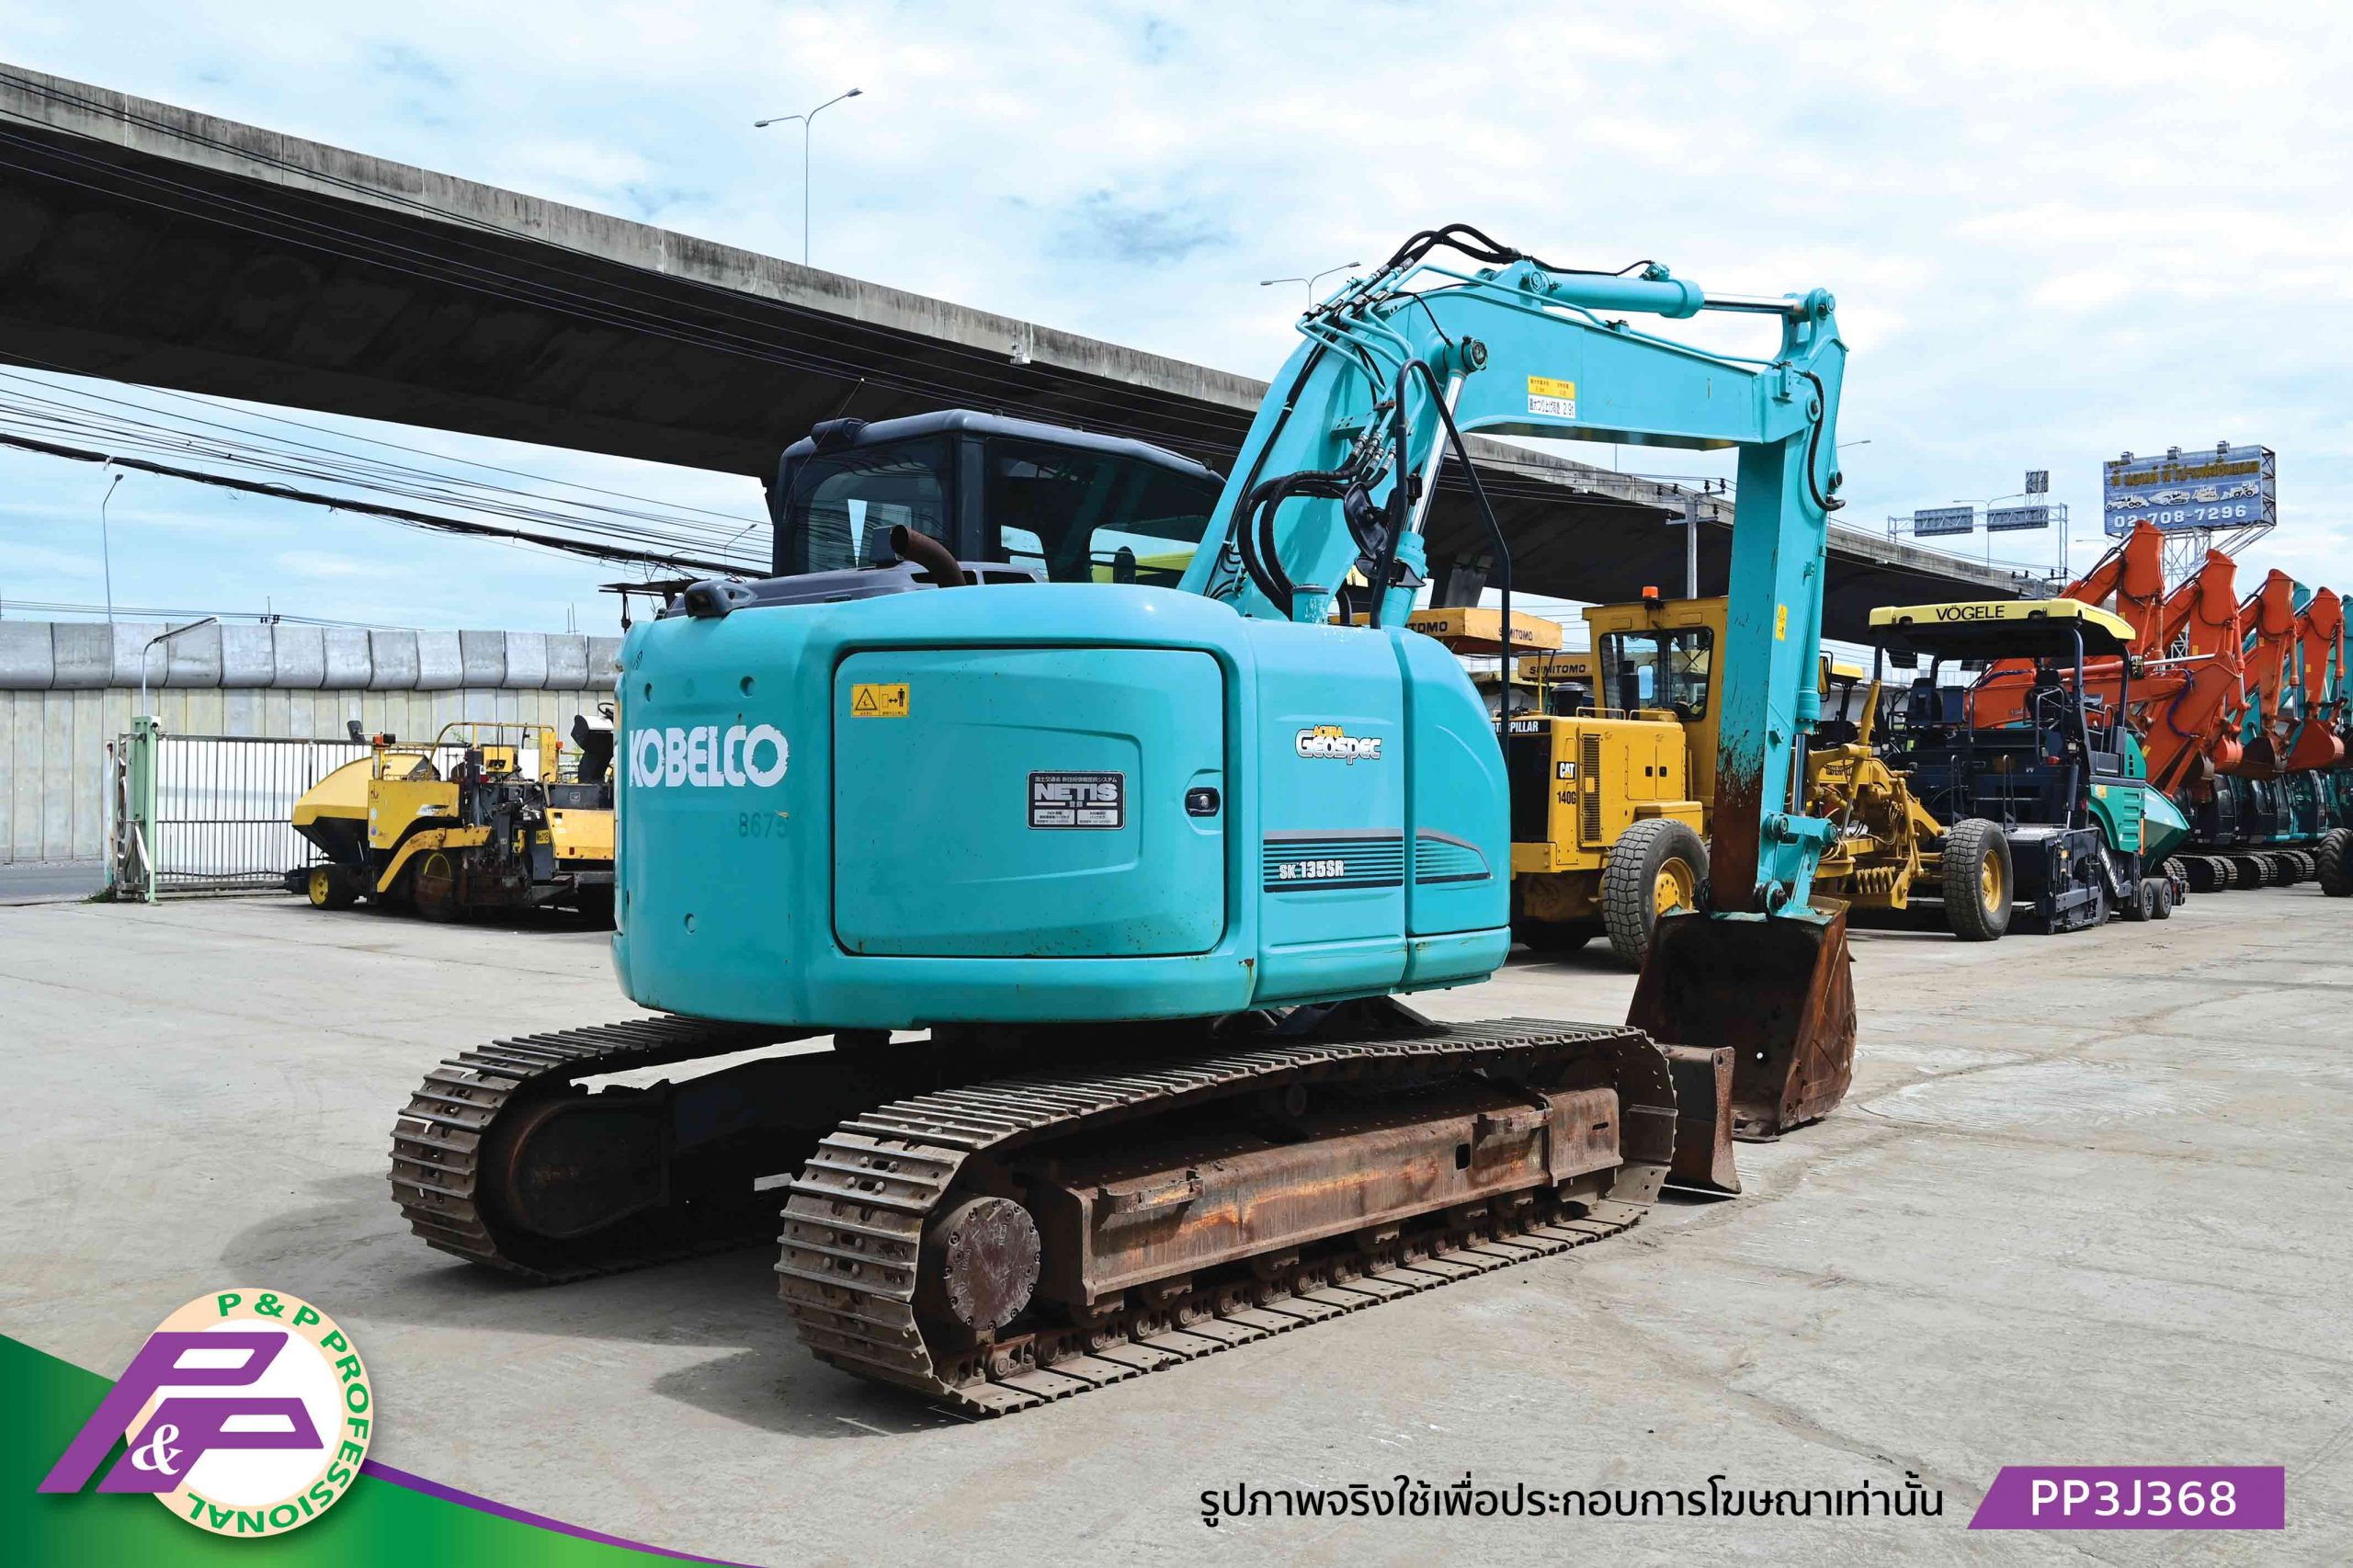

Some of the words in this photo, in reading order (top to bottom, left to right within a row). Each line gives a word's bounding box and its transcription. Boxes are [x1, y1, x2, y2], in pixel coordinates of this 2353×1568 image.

[2114, 505, 2247, 528] 02708-7296
[1936, 605, 2006, 621] VÖGELE
[629, 723, 789, 788] KOBELCO
[1559, 762, 1575, 778] CAT
[1034, 782, 1119, 801] NETIS
[1557, 790, 1576, 805] 140G
